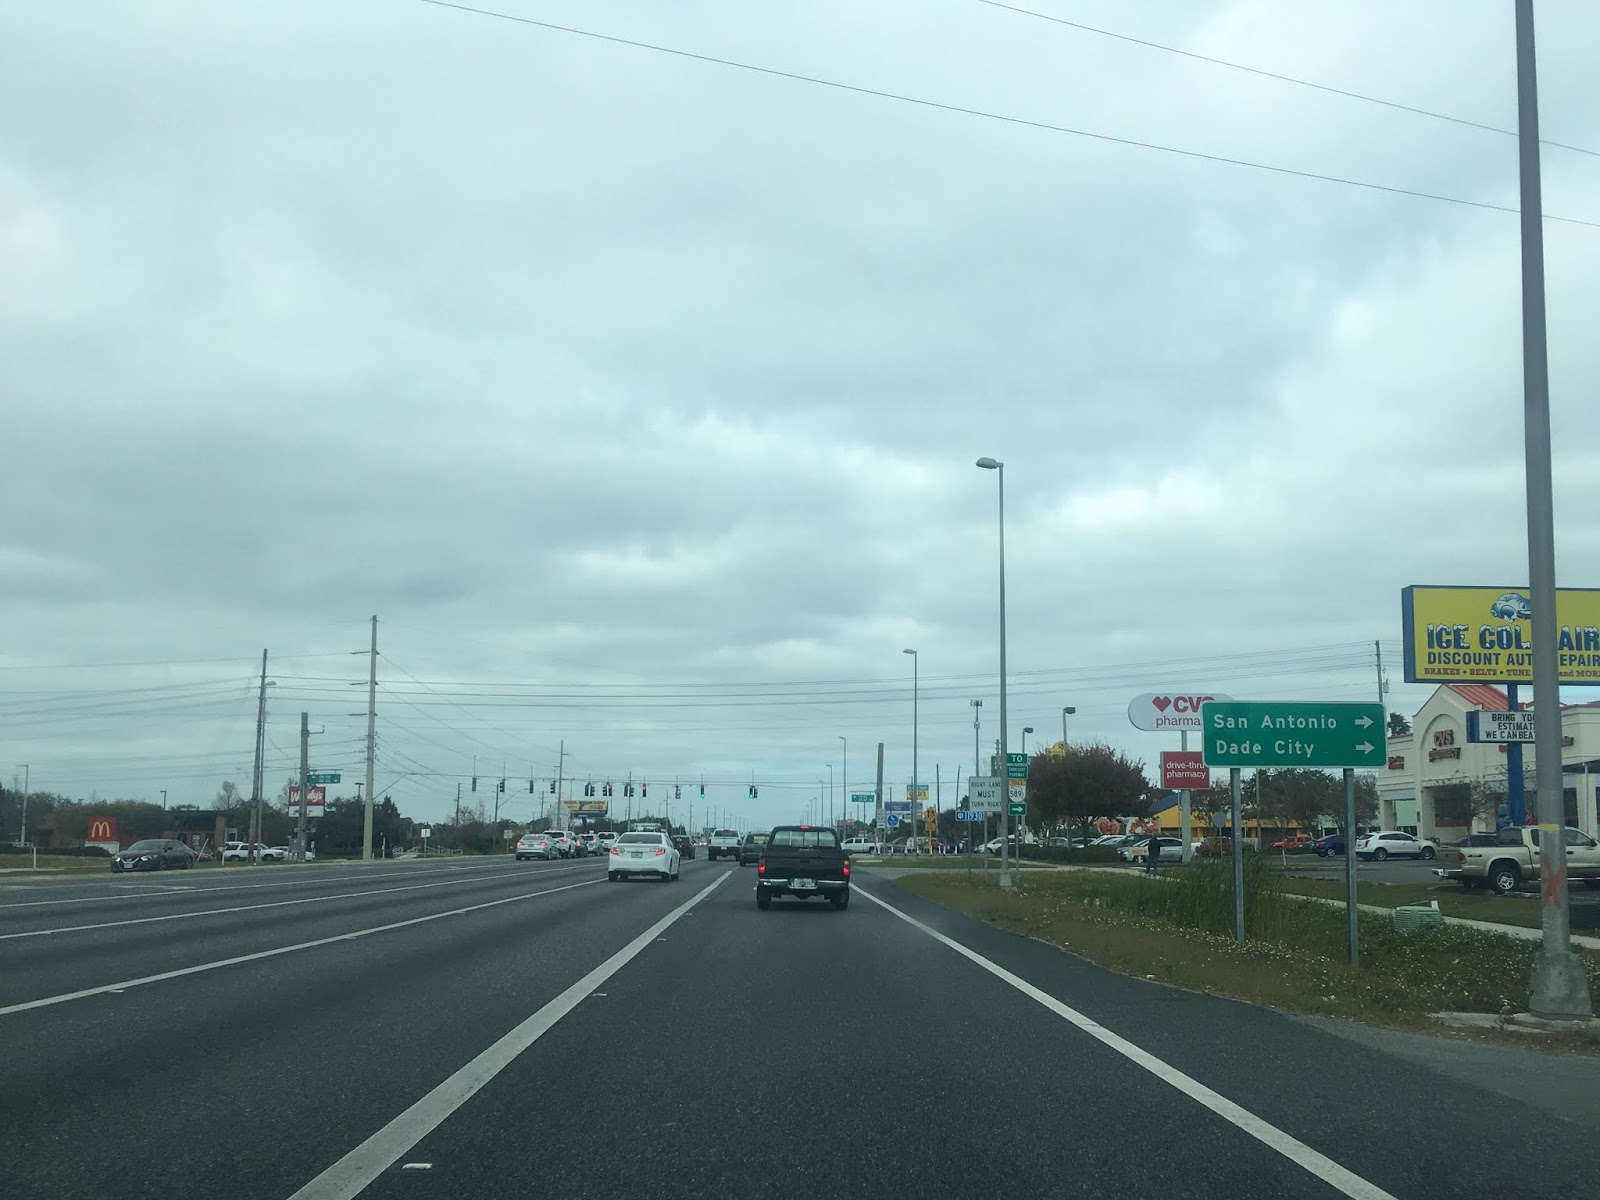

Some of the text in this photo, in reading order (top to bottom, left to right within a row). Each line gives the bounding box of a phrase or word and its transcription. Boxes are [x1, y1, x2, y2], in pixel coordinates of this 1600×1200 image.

[1427, 623, 1600, 651] ICE COL AIR
[1427, 651, 1600, 667] DISCOUNT AUT EPAIR
[1424, 667, 1461, 676] BRAKES
[1469, 668, 1498, 676] BELTS
[1576, 670, 1600, 678] MOR
[1156, 714, 1201, 728] pharma
[1213, 714, 1337, 729] San Antonio
[1491, 713, 1535, 722] BRING YO
[1433, 729, 1455, 747] CVS
[1485, 730, 1497, 739] WE
[1518, 730, 1536, 739] BEA
[1216, 739, 1315, 758] Dade City
[1011, 754, 1023, 763] TO
[1166, 761, 1205, 769] drive-thru
[1166, 770, 1206, 779] pharmacy
[290, 789, 323, 803] Wdy's
[977, 790, 995, 798] MUST
[1010, 790, 1021, 798] 589
